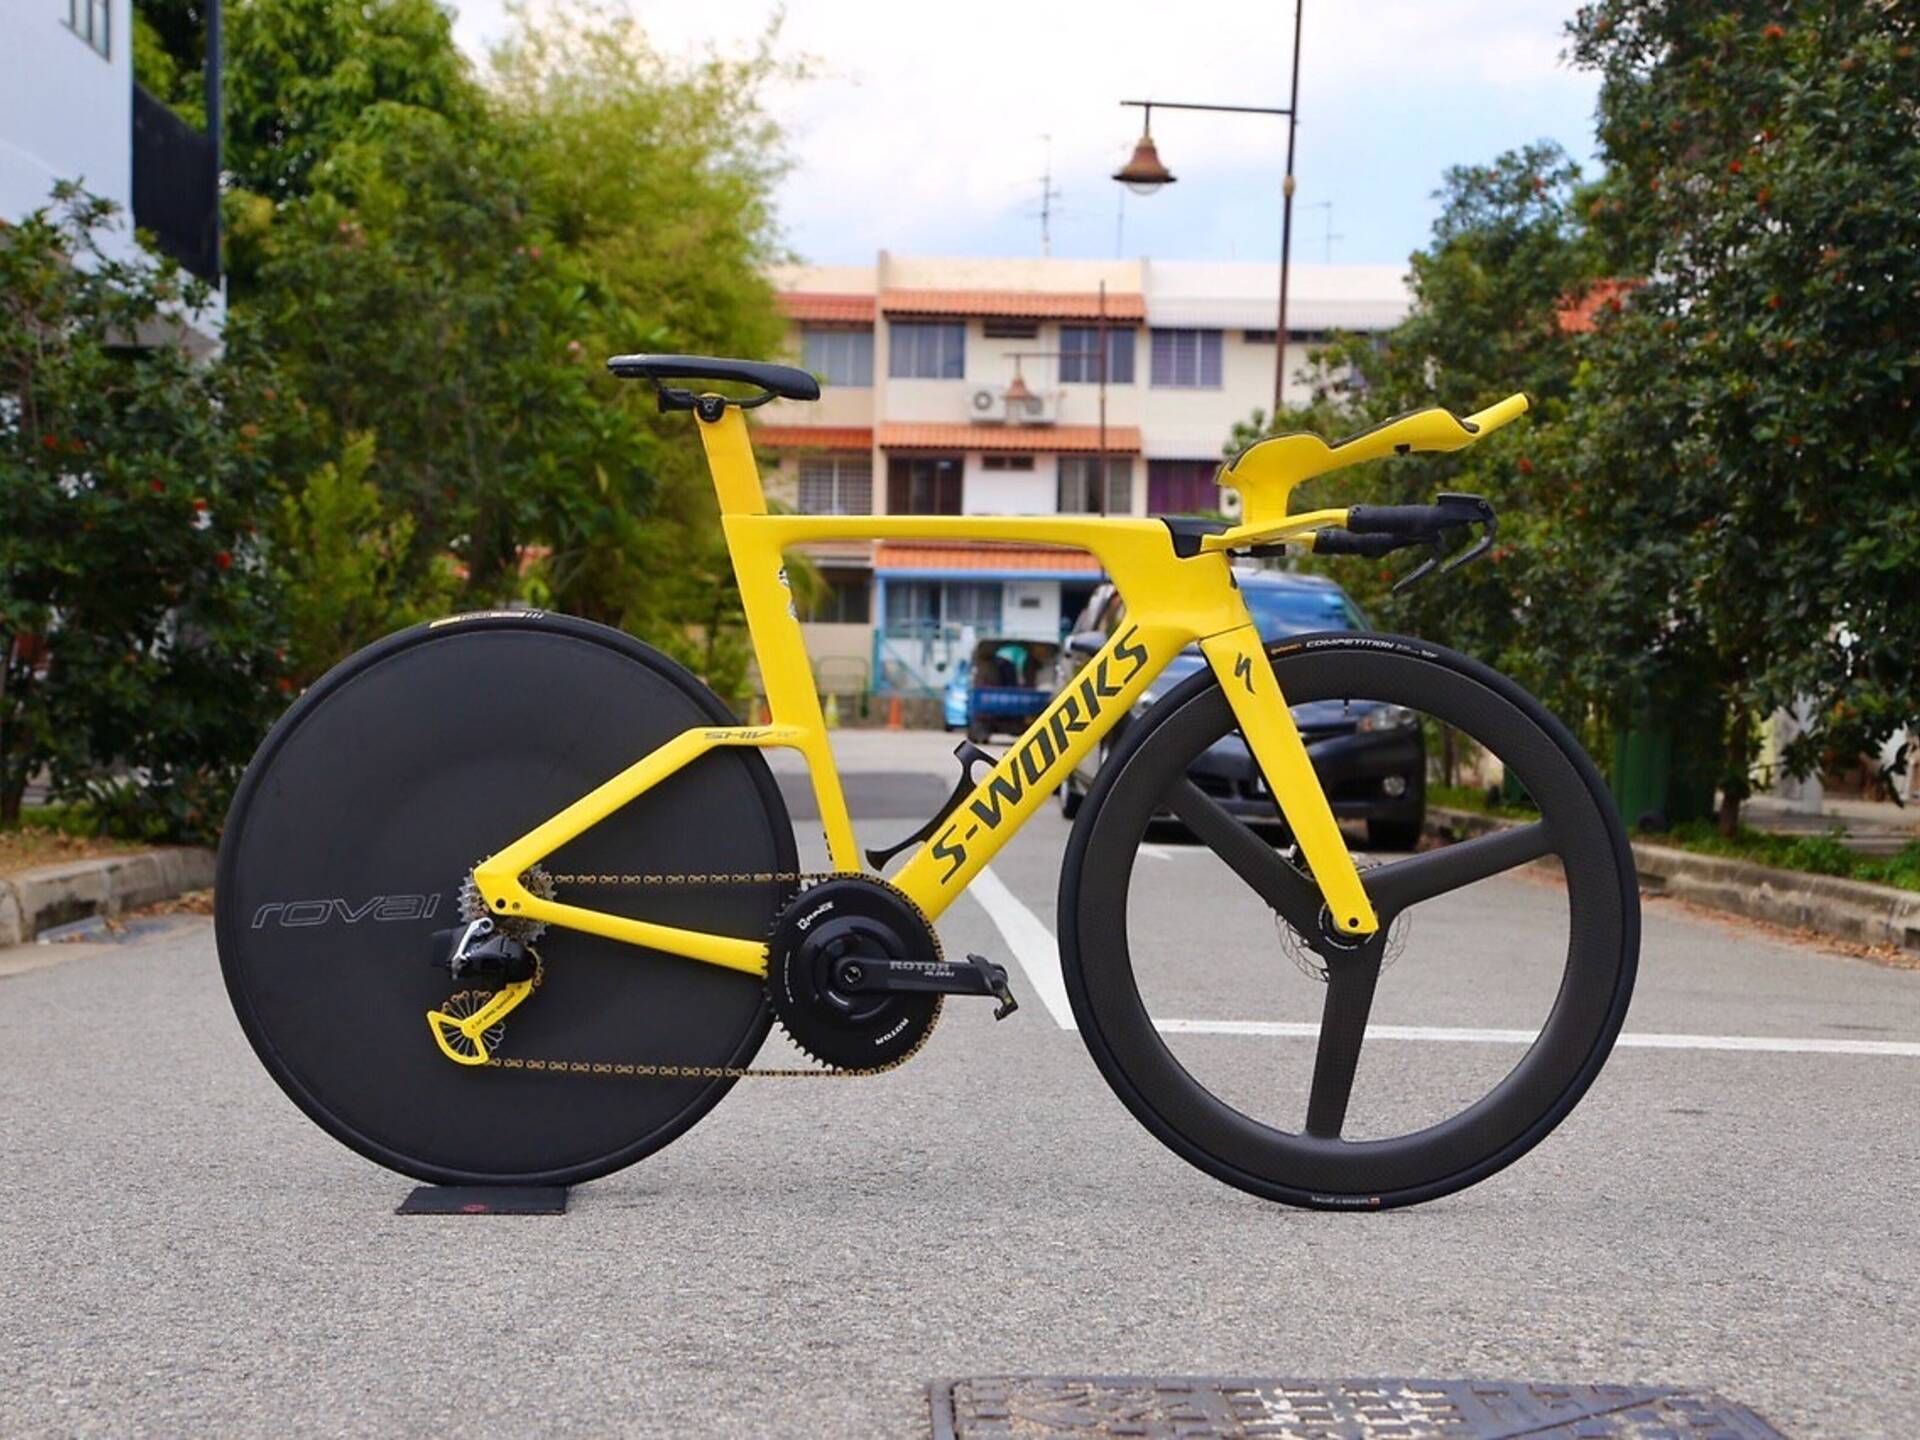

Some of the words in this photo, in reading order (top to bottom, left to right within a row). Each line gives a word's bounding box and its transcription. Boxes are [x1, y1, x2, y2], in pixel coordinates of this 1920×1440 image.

[1306, 638, 1394, 649] COMPETITION
[932, 624, 1148, 884] S-WORKS
[251, 893, 441, 928] roval
[890, 961, 950, 970] ROTOR
[875, 1018, 909, 1045] ROTOR
